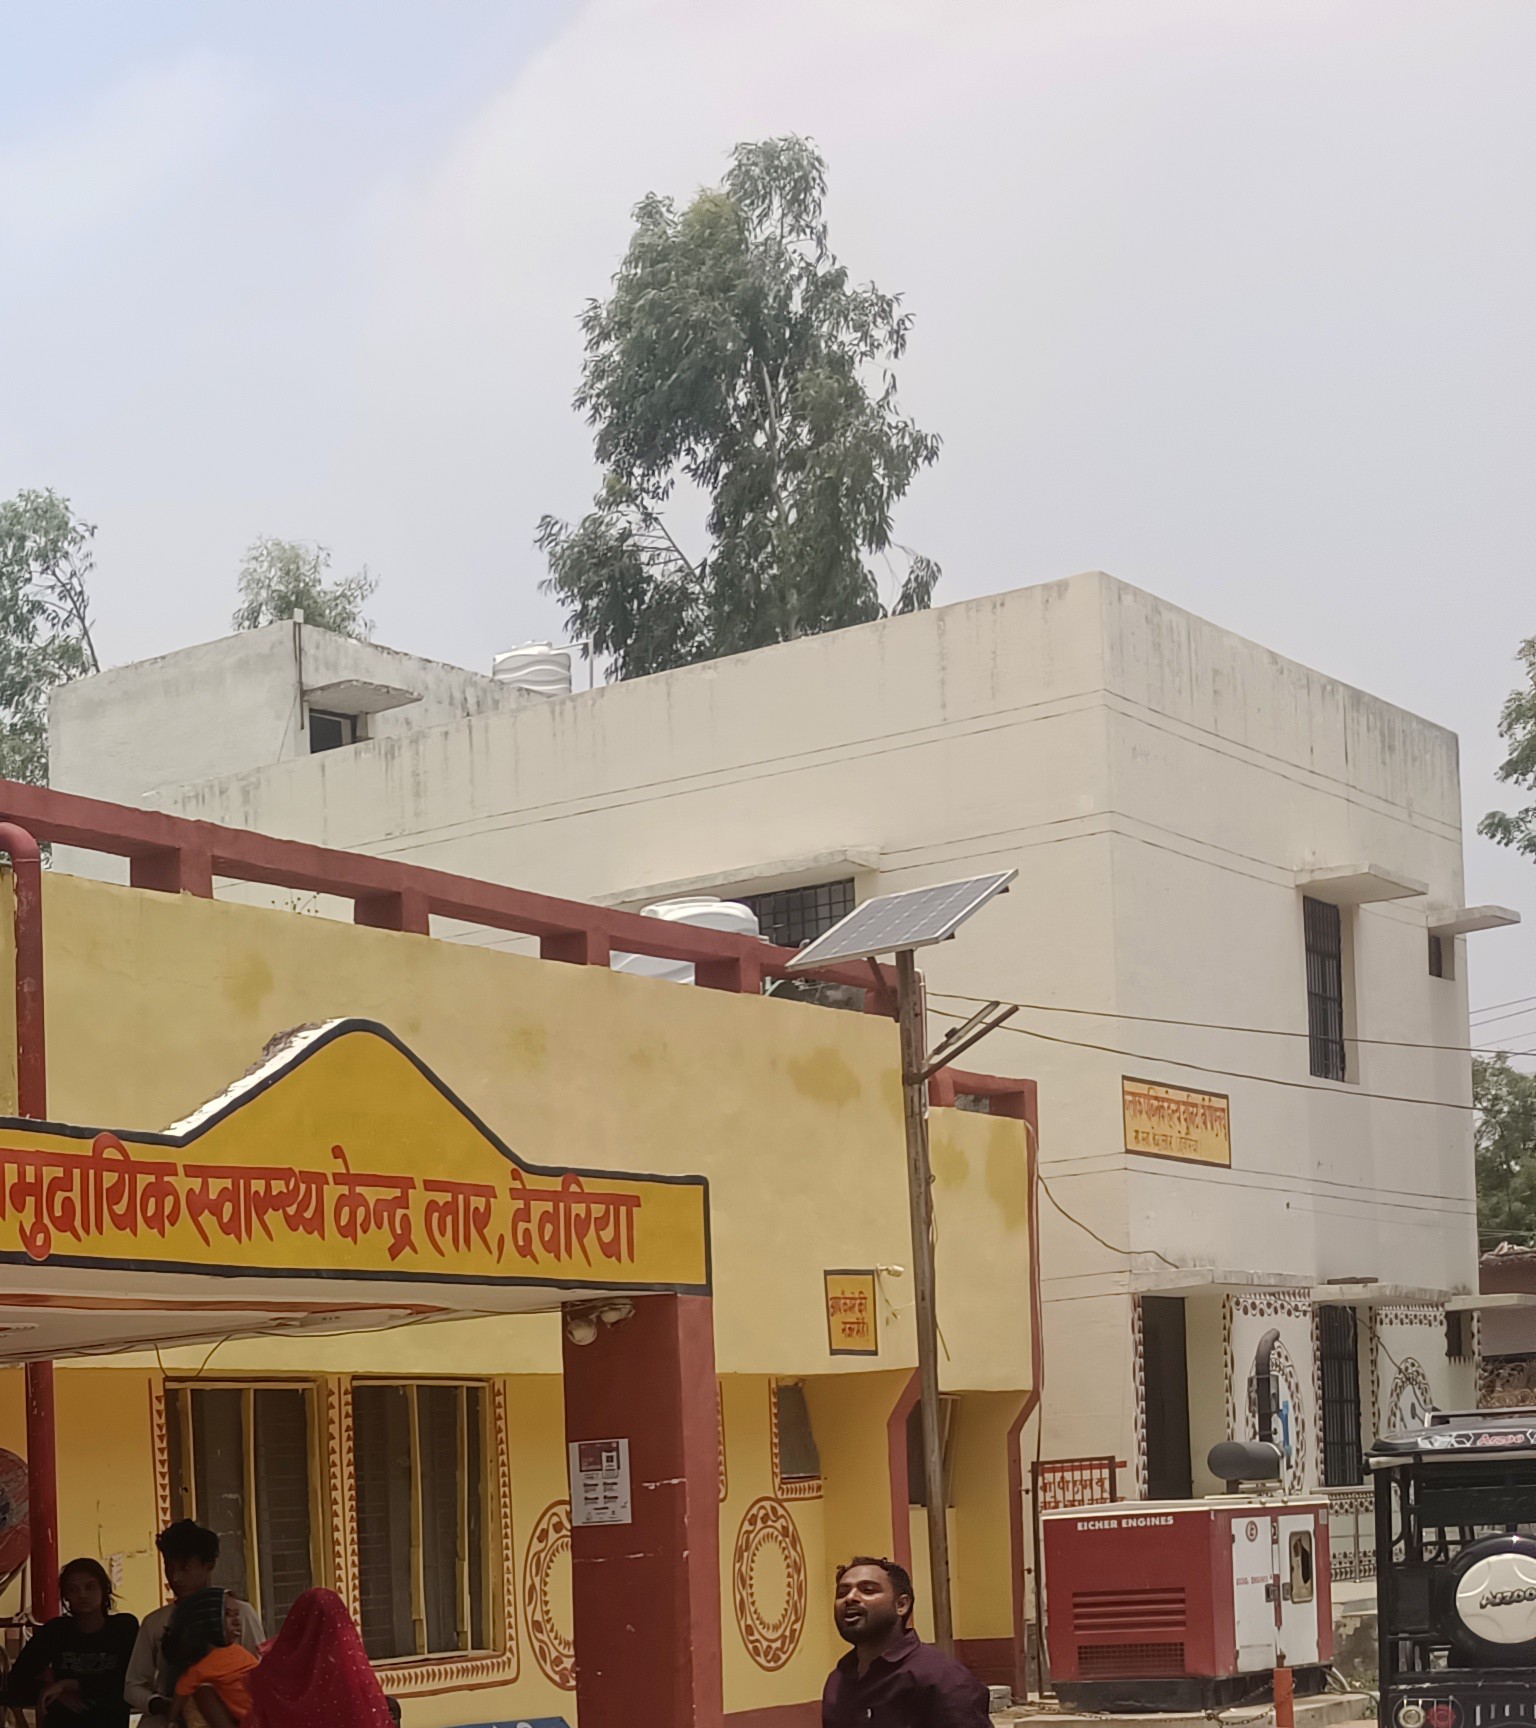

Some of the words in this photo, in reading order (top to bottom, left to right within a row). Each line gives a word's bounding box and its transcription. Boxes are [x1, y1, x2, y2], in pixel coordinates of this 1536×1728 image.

[183, 1163, 326, 1246] स्वास्थ्य
[331, 1146, 416, 1261] केन्द्र
[423, 1179, 505, 1266] लार,
[508, 1169, 641, 1268] देवरिया
[1077, 1520, 1118, 1531] EICHER
[1122, 1516, 1174, 1528] ENGINES
